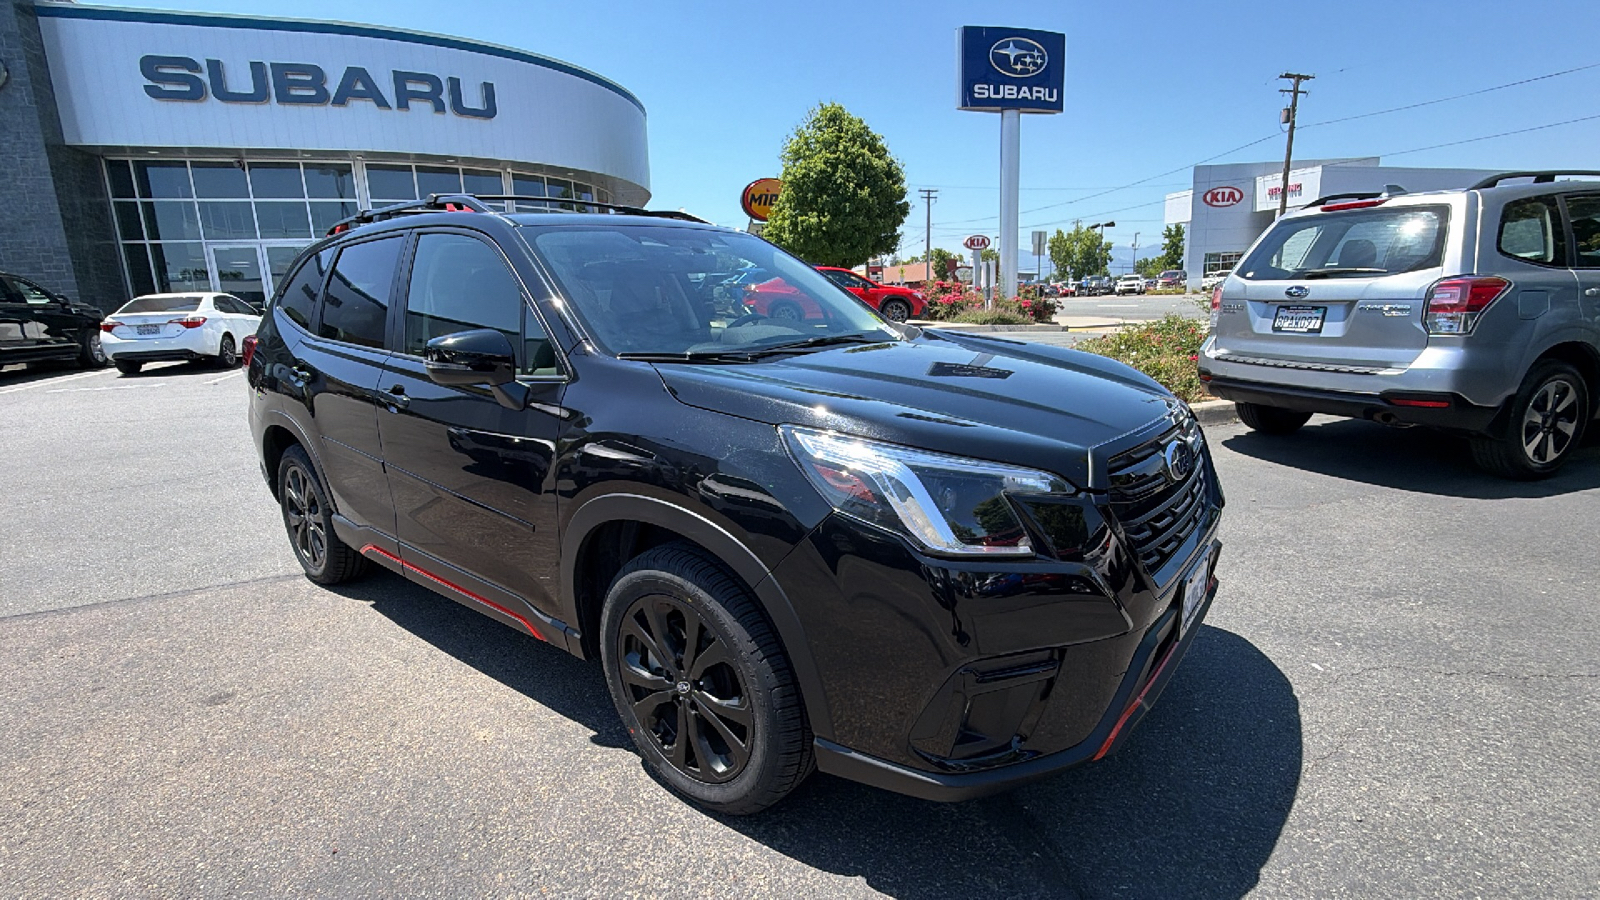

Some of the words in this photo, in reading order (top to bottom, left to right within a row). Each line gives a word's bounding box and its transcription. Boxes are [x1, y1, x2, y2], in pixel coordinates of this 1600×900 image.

[139, 54, 497, 119] SUBARU
[973, 83, 1057, 102] SUBARU
[749, 193, 779, 206] MID
[1210, 191, 1237, 203] KIA
[970, 237, 987, 247] KIA
